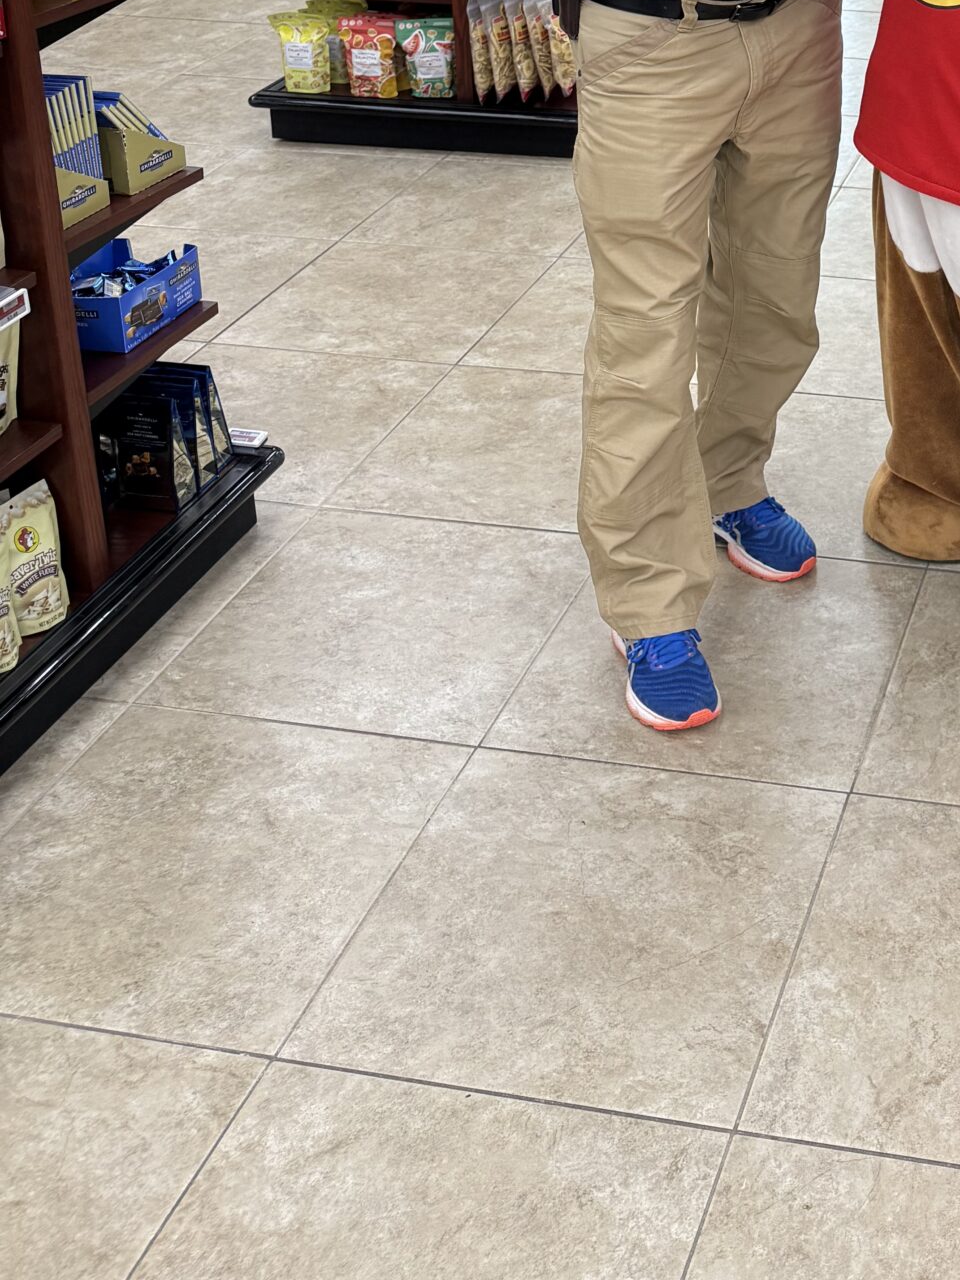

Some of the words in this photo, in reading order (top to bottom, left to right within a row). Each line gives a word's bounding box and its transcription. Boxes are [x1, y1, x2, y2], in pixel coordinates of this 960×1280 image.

[140, 151, 172, 172] GHIRARDELLI
[62, 186, 96, 209] GHIRARDELLI
[169, 263, 197, 285] GHIRARDELLI
[184, 287, 193, 297] SALT
[20, 570, 40, 589] WHITE
[39, 566, 56, 578] FUDGE
